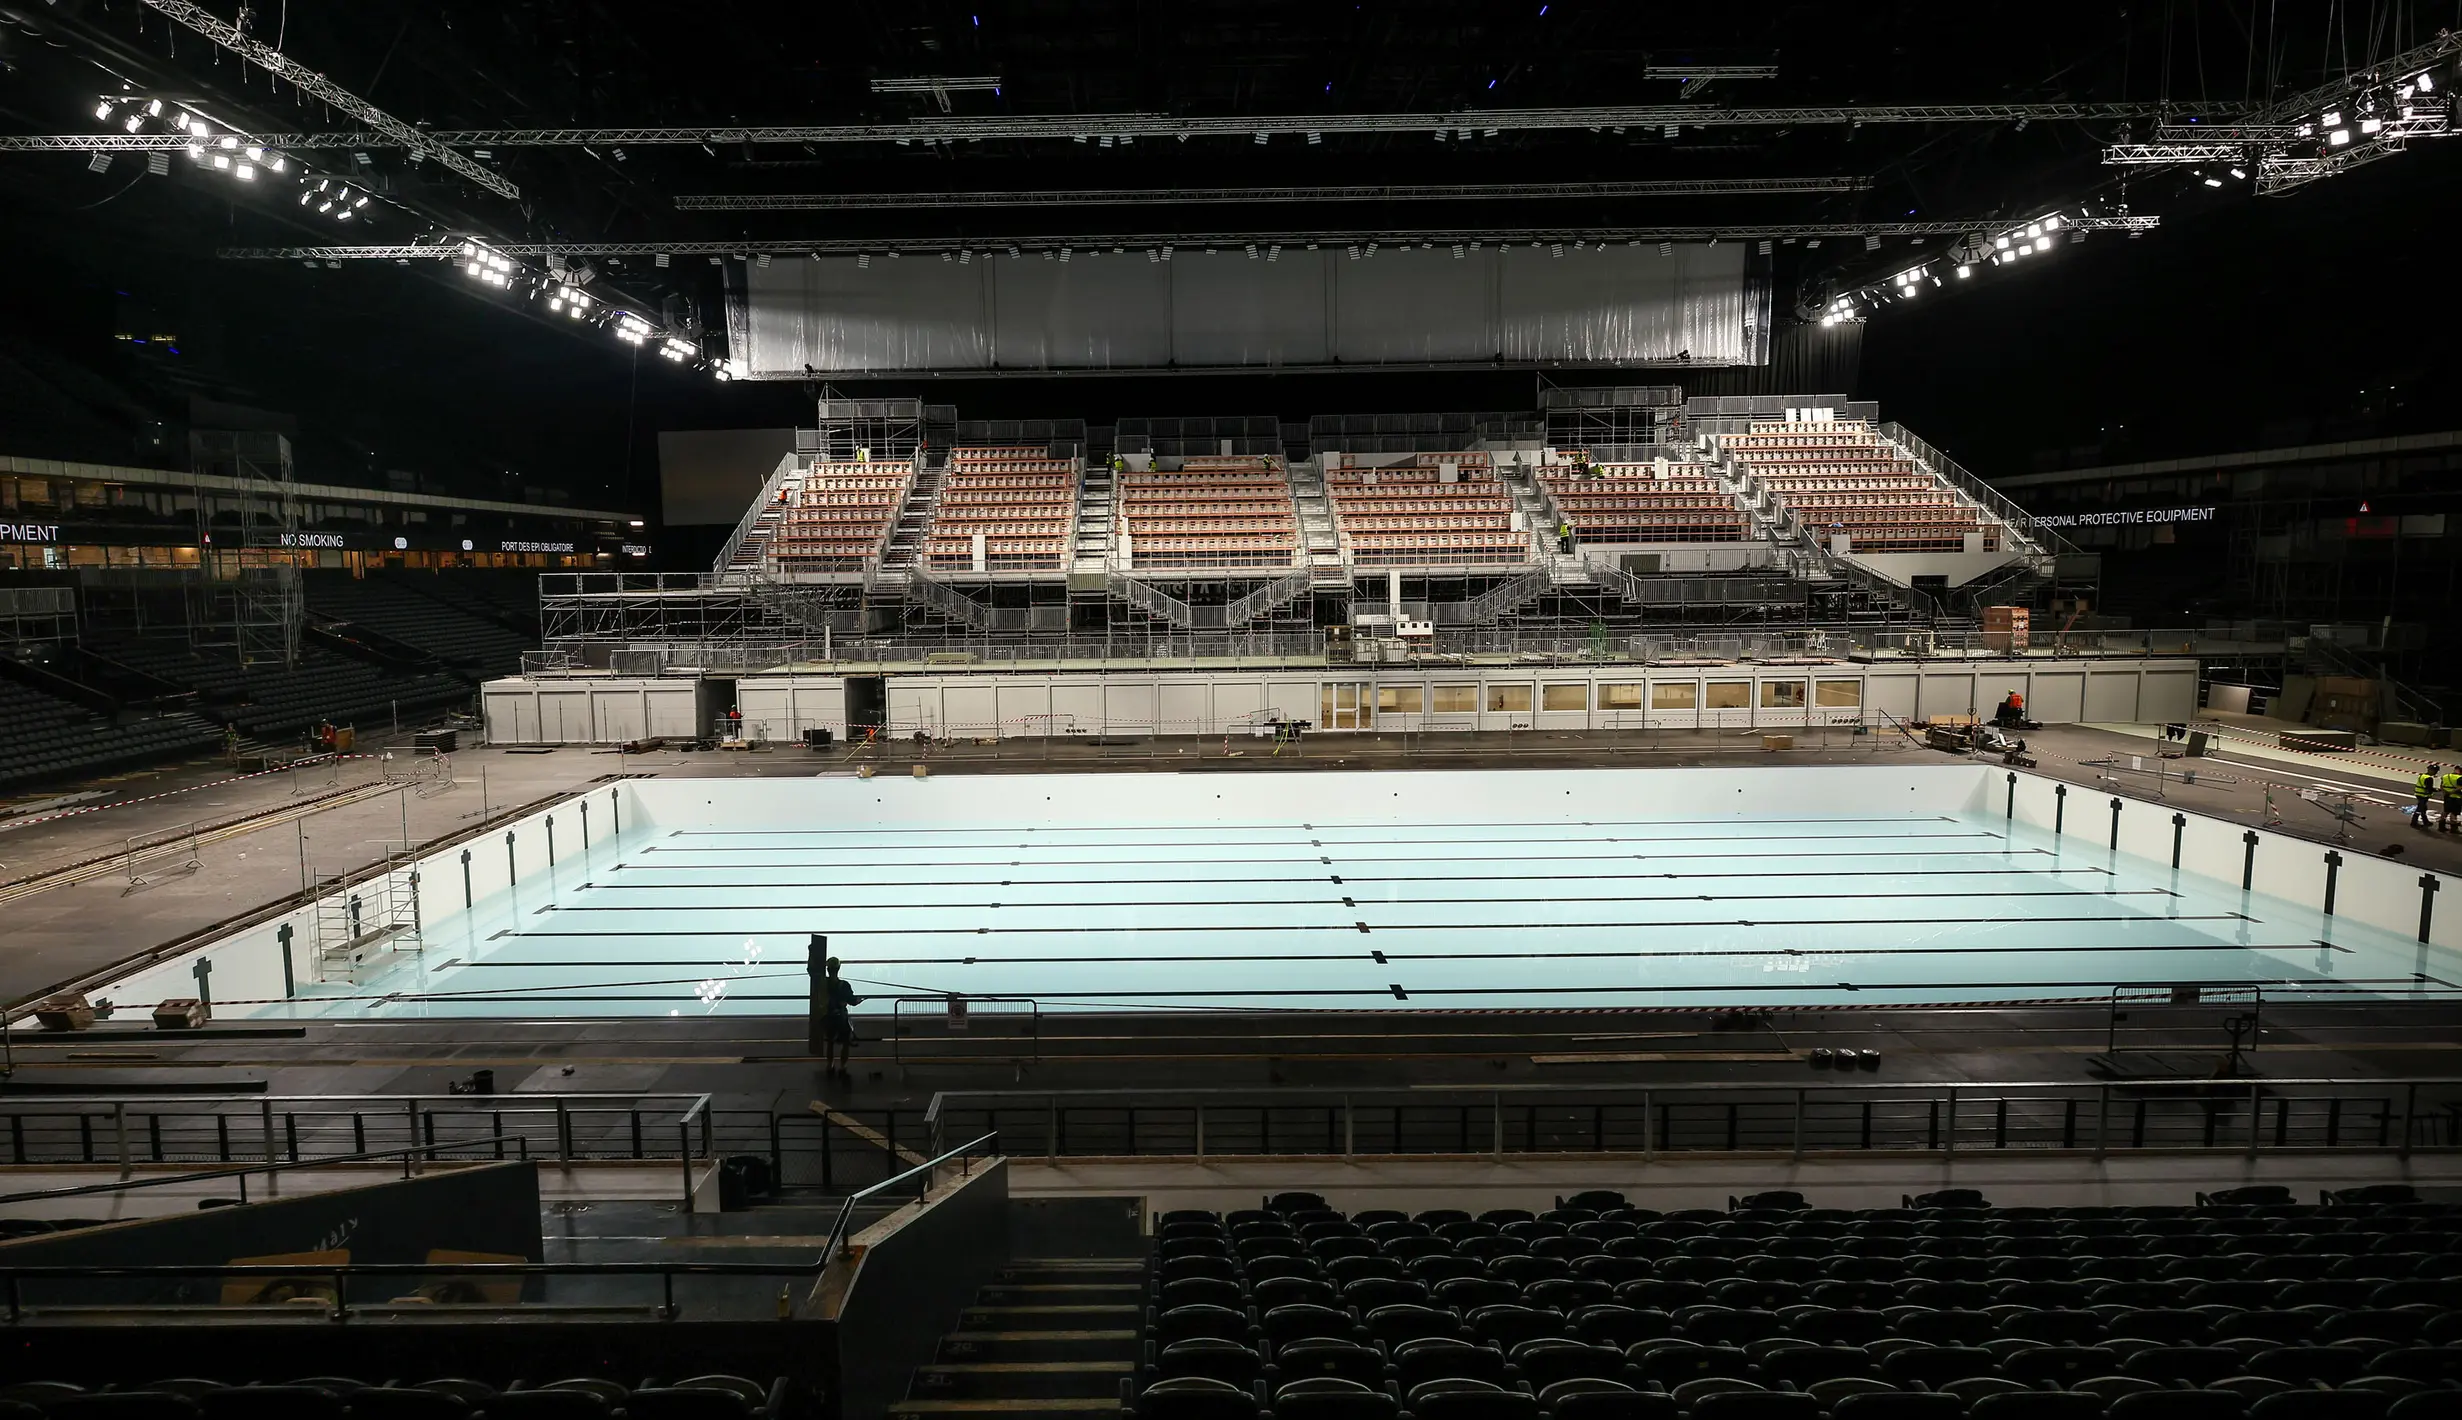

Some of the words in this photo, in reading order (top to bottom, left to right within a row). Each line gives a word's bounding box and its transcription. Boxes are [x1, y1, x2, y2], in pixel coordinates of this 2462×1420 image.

[2079, 511, 2144, 525] PROTECTIVE
[2146, 507, 2216, 523] EQUIPMENT
[0, 524, 59, 541] PMENT
[280, 533, 297, 546] NO
[298, 534, 344, 547] SMOKING
[501, 541, 518, 551] PORT
[518, 542, 530, 551] DES
[531, 542, 540, 551] EPI
[540, 542, 574, 552] OBLIGATOIRE
